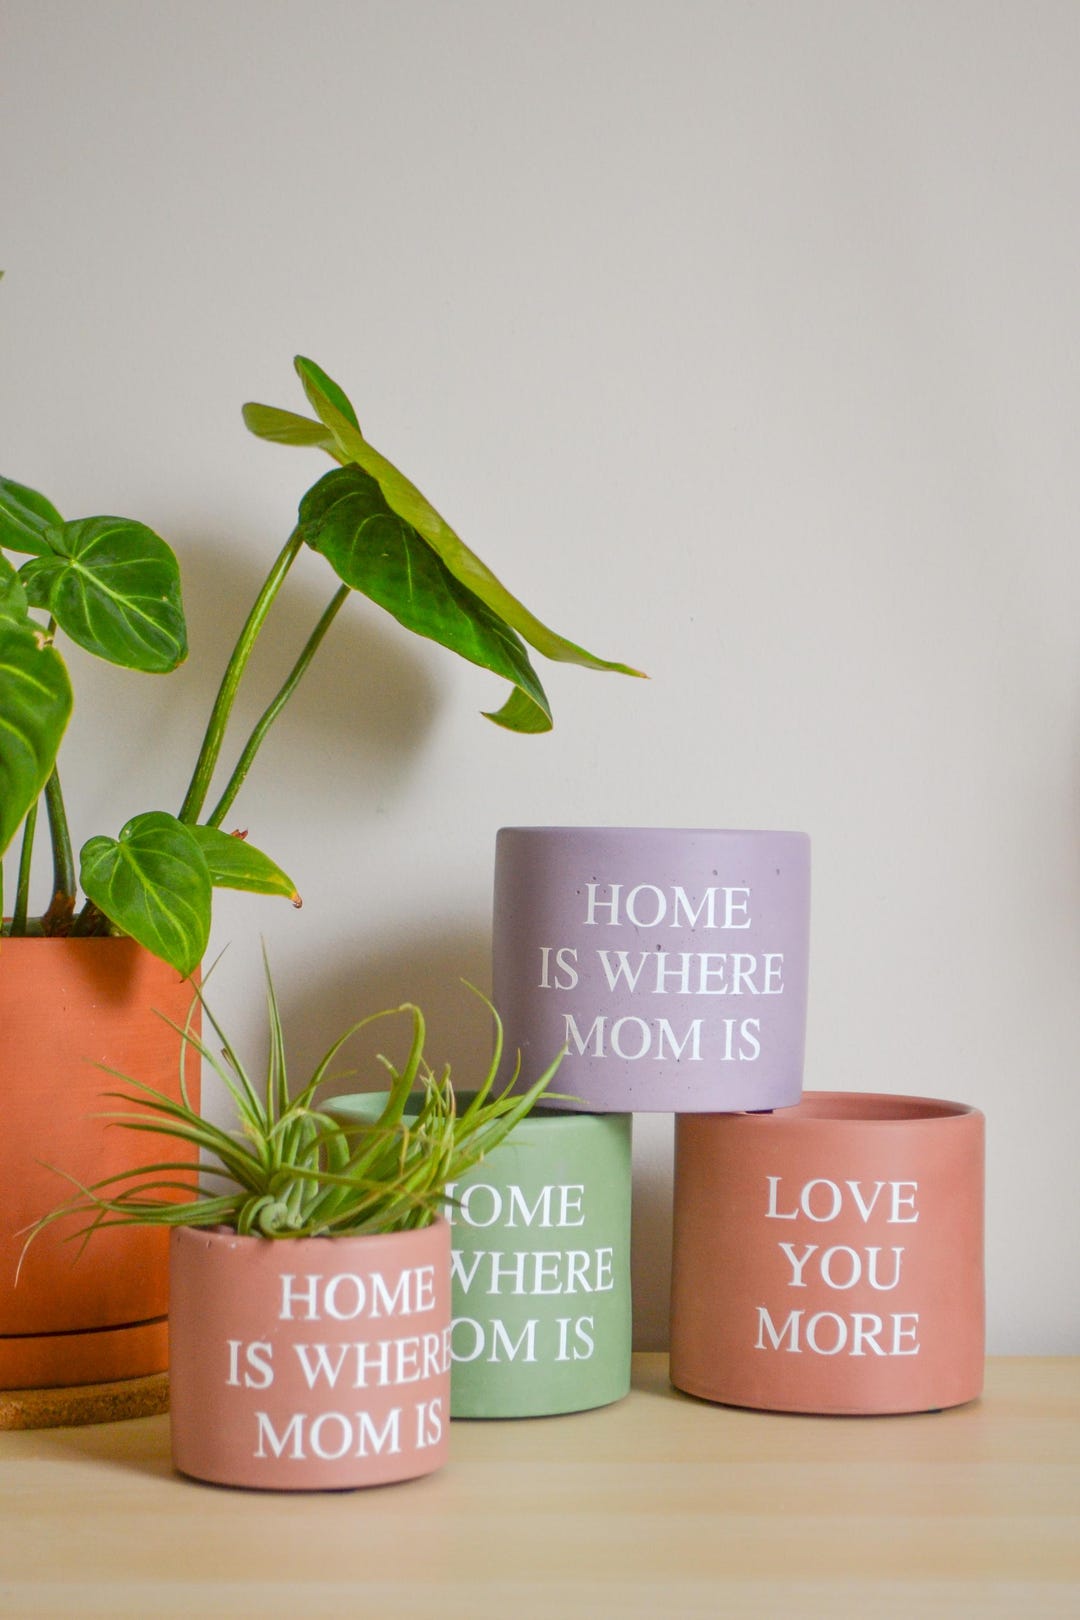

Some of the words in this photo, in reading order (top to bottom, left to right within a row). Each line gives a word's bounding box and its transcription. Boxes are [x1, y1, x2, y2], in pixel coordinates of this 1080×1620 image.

[584, 883, 751, 929] HOME
[538, 947, 579, 990] IS
[596, 950, 784, 995] WHERE
[562, 1014, 704, 1060] MOM
[720, 1018, 761, 1061] IS
[765, 1176, 920, 1223] LOVE
[778, 1242, 905, 1290] YOU
[278, 1265, 436, 1321] HOME
[450, 1317, 540, 1362] OM
[554, 1315, 595, 1361] IS
[754, 1306, 921, 1356] MORE
[225, 1340, 275, 1389] IS
[253, 1408, 402, 1460] MOM
[415, 1398, 443, 1448] IS
